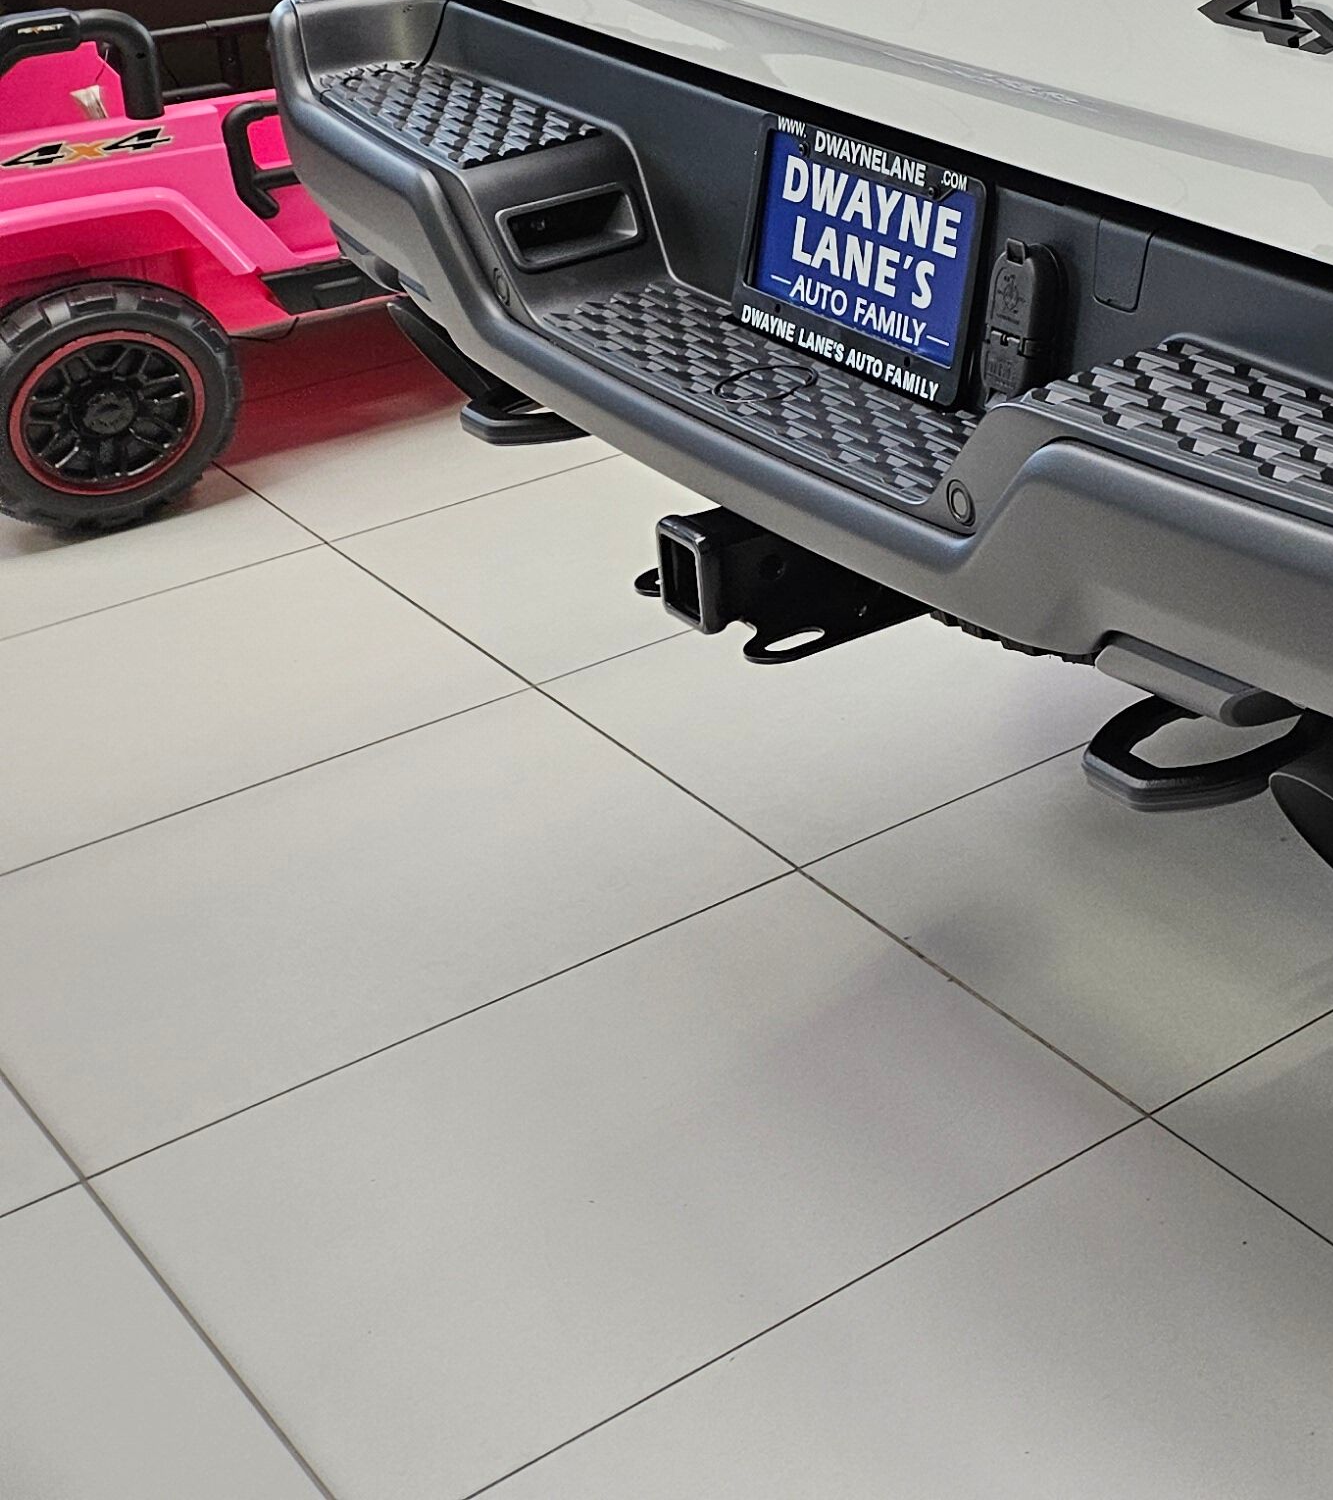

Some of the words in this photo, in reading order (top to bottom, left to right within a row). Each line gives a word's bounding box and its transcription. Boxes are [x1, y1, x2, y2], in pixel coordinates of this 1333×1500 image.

[781, 154, 962, 259] DWAYNE
[813, 130, 928, 188] DWAYNELANE
[790, 215, 936, 310] LANE'S
[740, 304, 797, 343] DWAYNE
[797, 327, 846, 364] LANE'S
[845, 348, 885, 380] AUTO
[883, 363, 940, 402] FAMILY
[788, 273, 849, 318] AUTO
[852, 296, 928, 348] FAMILY
